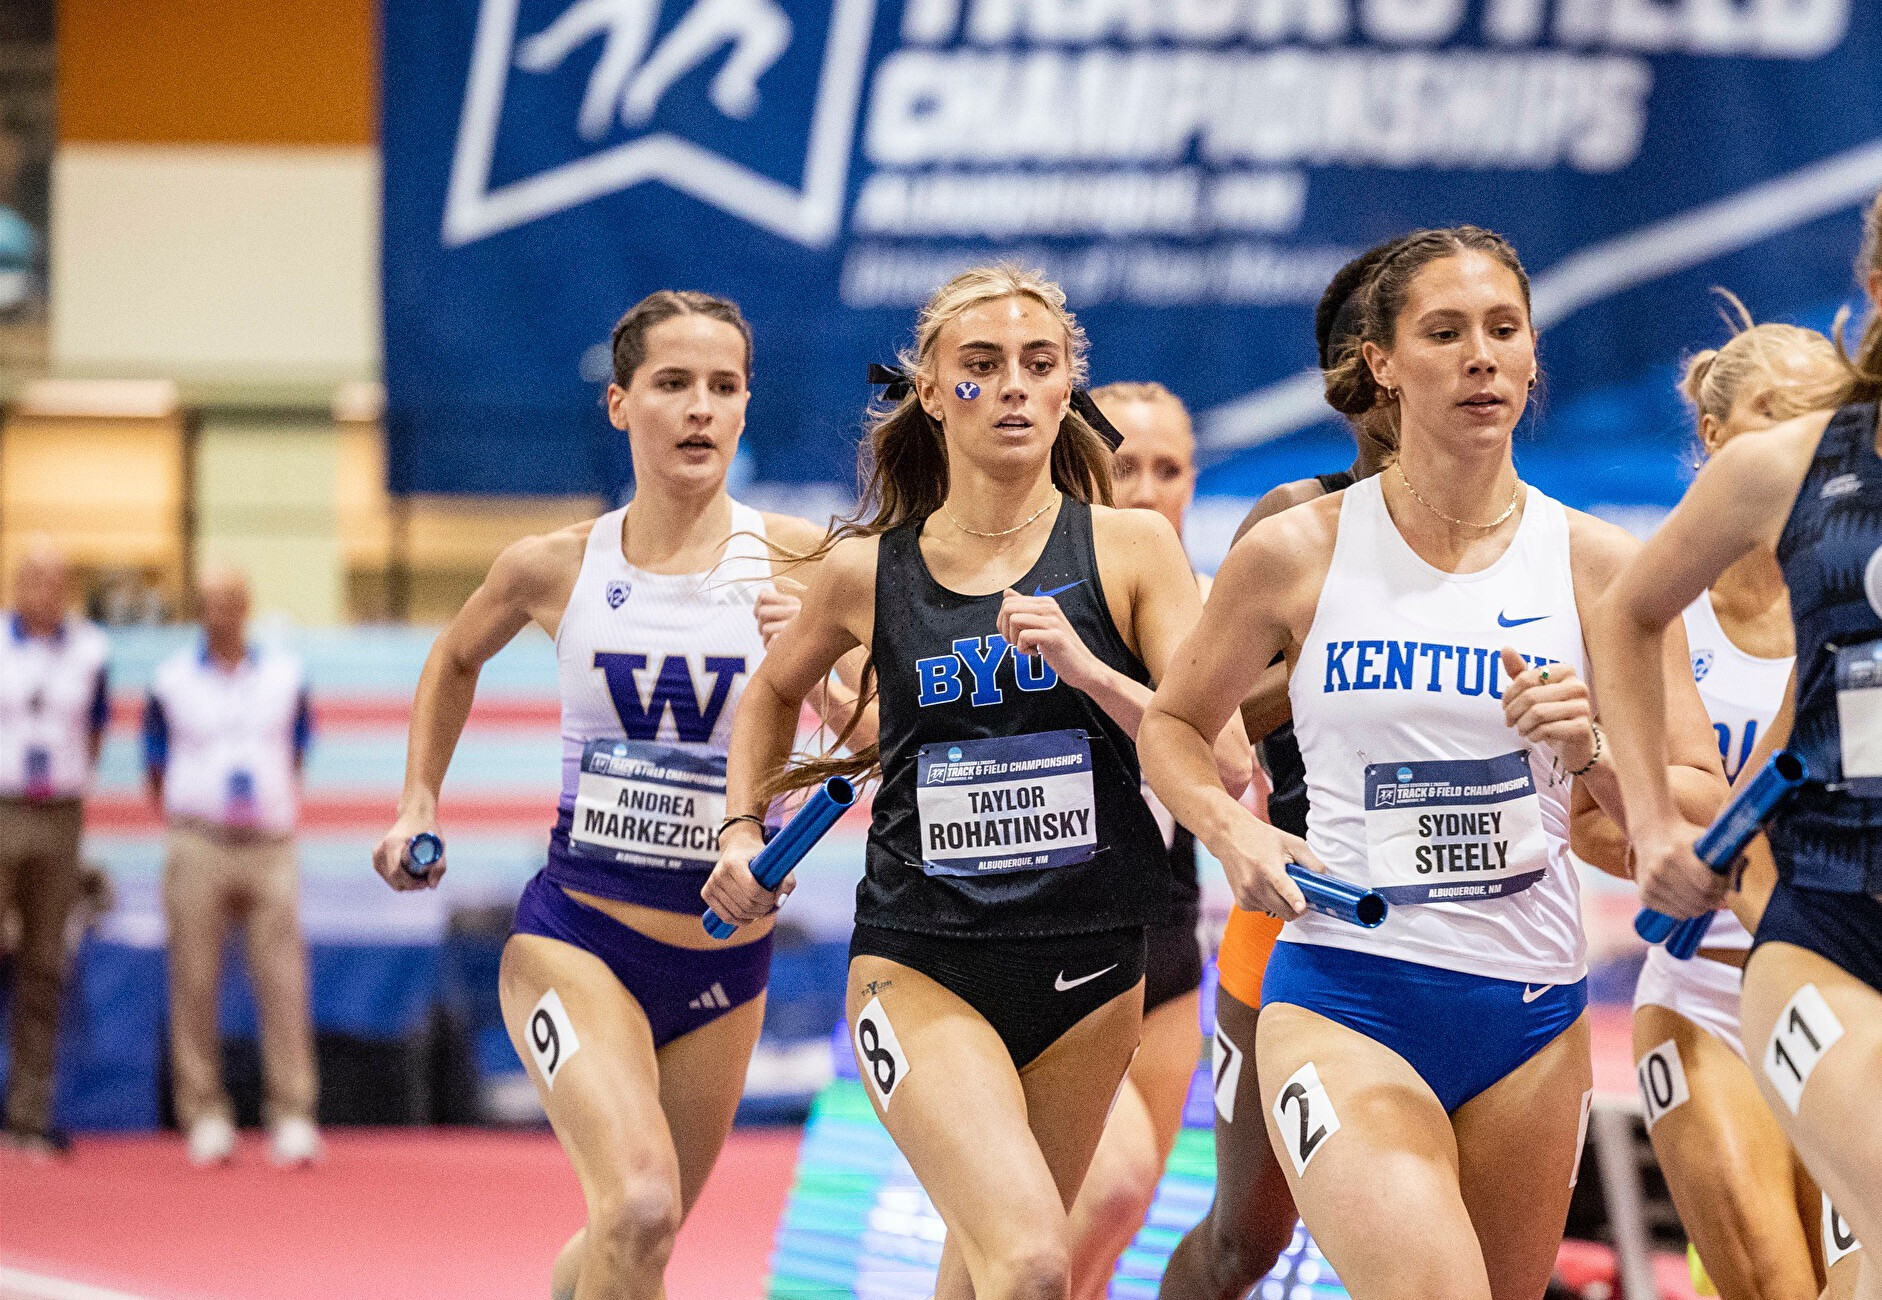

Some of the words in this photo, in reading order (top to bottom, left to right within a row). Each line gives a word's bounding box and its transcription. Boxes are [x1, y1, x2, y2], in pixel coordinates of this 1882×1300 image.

[957, 382, 978, 399] Y
[916, 633, 1059, 708] BYU
[592, 649, 748, 743] W
[947, 766, 975, 778] TRACK
[975, 765, 982, 776] &
[983, 763, 1007, 776] FIELD
[1009, 753, 1083, 774] CHAMPIONSHIPS
[617, 787, 695, 818] ANDREA
[968, 785, 1046, 814] TAYLOR
[1397, 787, 1428, 799] TRACK
[1436, 785, 1462, 798] FIELD
[1463, 775, 1530, 797] CHAMPIONSHIPS
[583, 808, 721, 852] MARKEZICH
[929, 808, 1090, 851] ROHATINSKY
[1418, 810, 1502, 838] SYDNEY
[978, 856, 1034, 871] ALBUQUERQUE,
[1035, 855, 1049, 866] NM
[1415, 840, 1508, 875] STEELY
[1428, 885, 1487, 898] ALBUQUERQUE,
[1488, 884, 1502, 894] NM
[531, 1008, 560, 1075] 9
[859, 1017, 896, 1096] 8
[1774, 1005, 1821, 1084] 11
[1637, 1052, 1673, 1120] 10
[1279, 1081, 1328, 1164] 2
